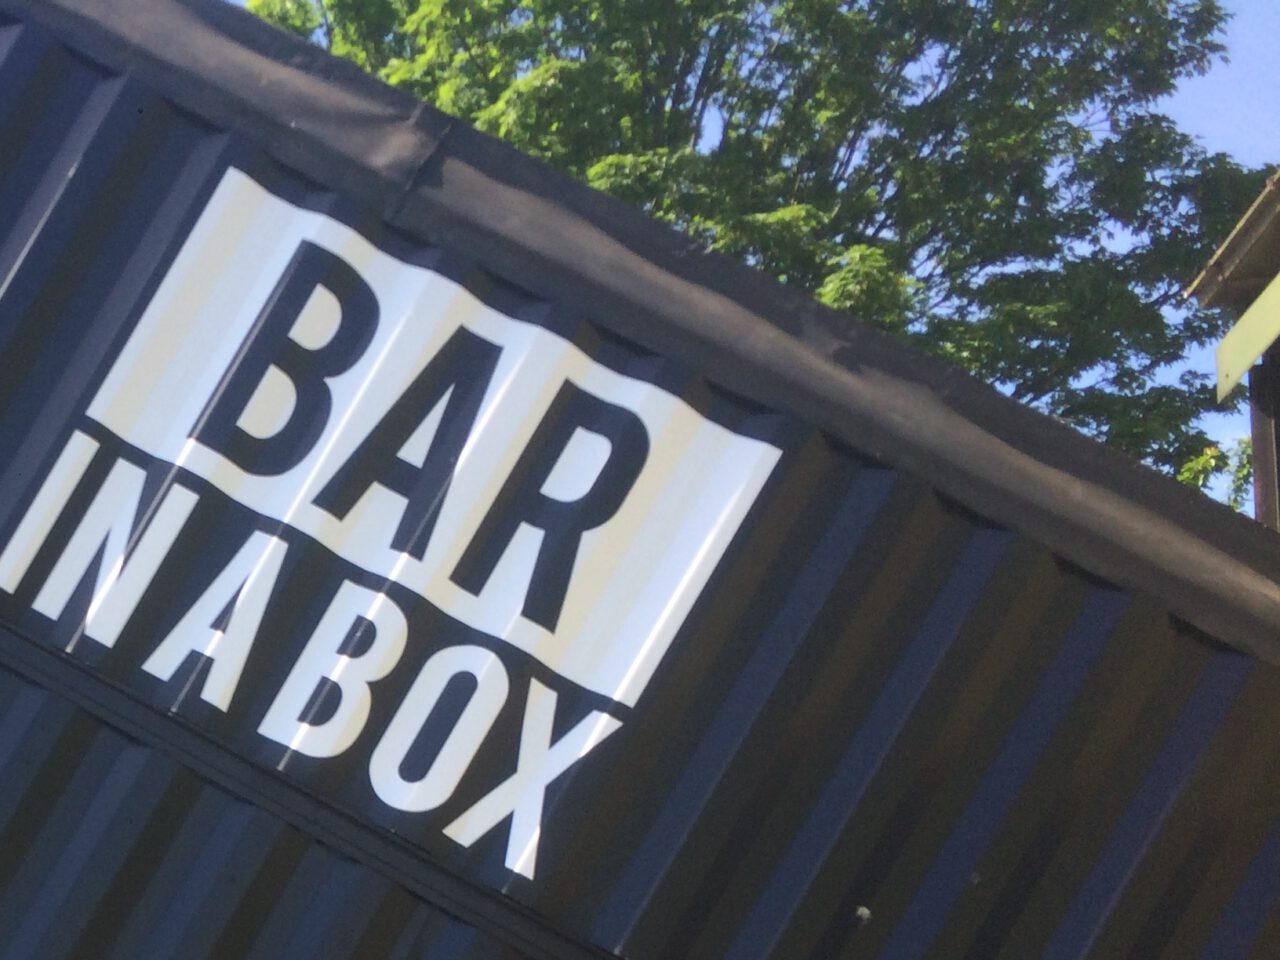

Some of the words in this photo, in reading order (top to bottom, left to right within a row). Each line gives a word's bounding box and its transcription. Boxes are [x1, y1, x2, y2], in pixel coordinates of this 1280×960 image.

[187, 239, 650, 635] BAR
[141, 530, 288, 712] A
[257, 579, 622, 880] BOX
